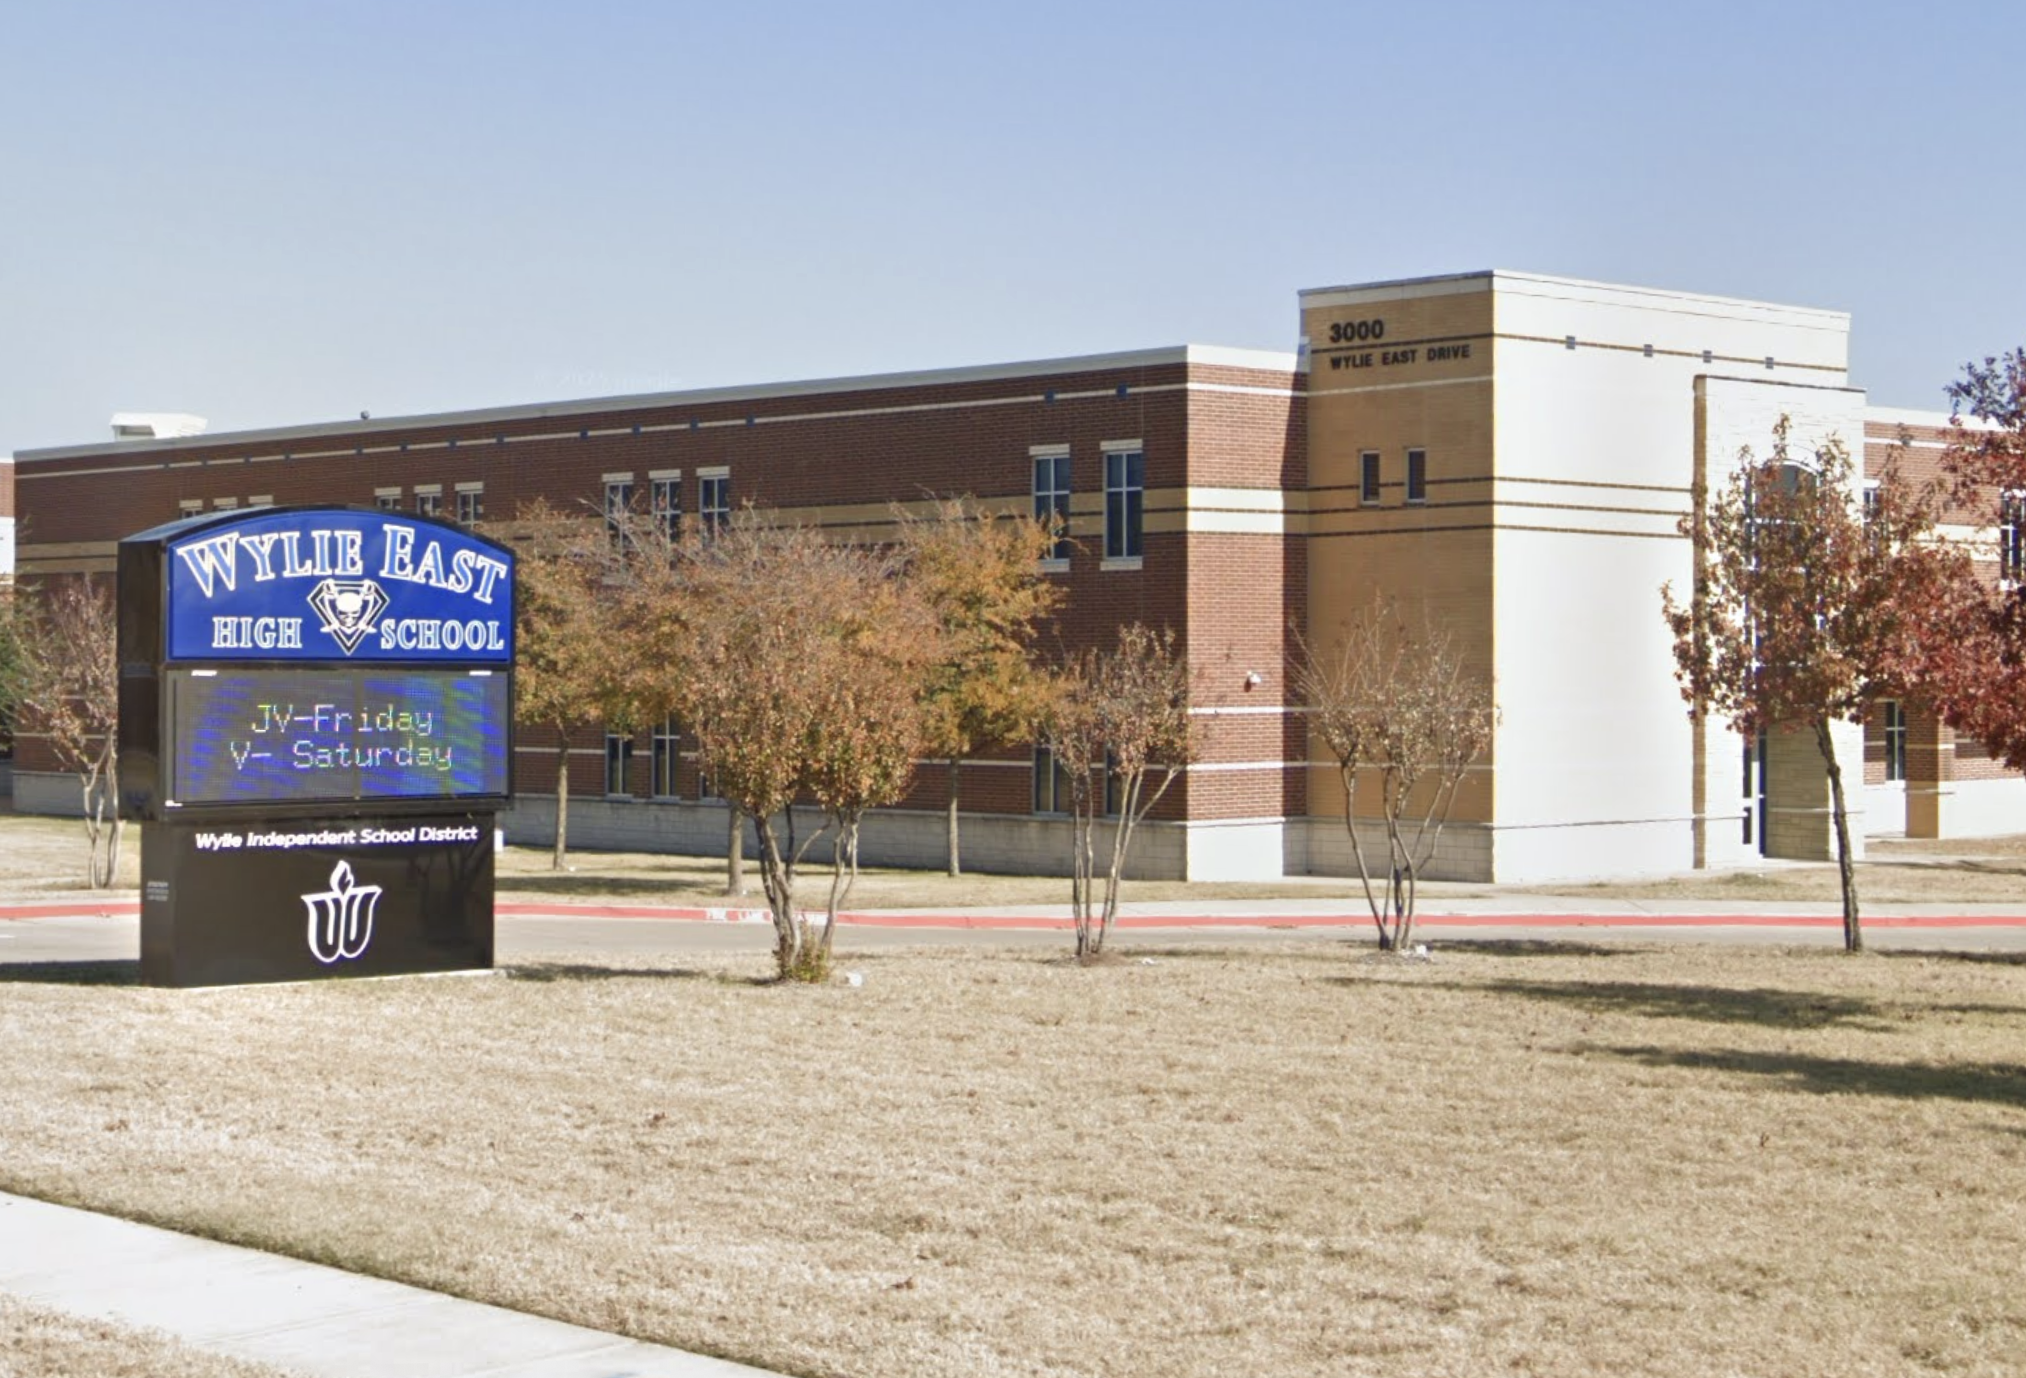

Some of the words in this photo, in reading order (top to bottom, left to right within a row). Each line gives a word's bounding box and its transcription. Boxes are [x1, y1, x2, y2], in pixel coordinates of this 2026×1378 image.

[1330, 319, 1384, 342] 3000
[1330, 354, 1372, 370] WYLIE
[1382, 350, 1418, 366] EAST
[1427, 345, 1470, 361] DRIVE
[211, 616, 302, 648] HIGH
[380, 618, 504, 650] SCHOOL
[251, 703, 432, 736] JV-Friday
[230, 740, 272, 771] V-
[292, 739, 452, 771] Saturday
[195, 833, 242, 850] Wylie
[246, 831, 356, 847] Independent
[359, 828, 415, 843] School
[418, 826, 478, 841] District
